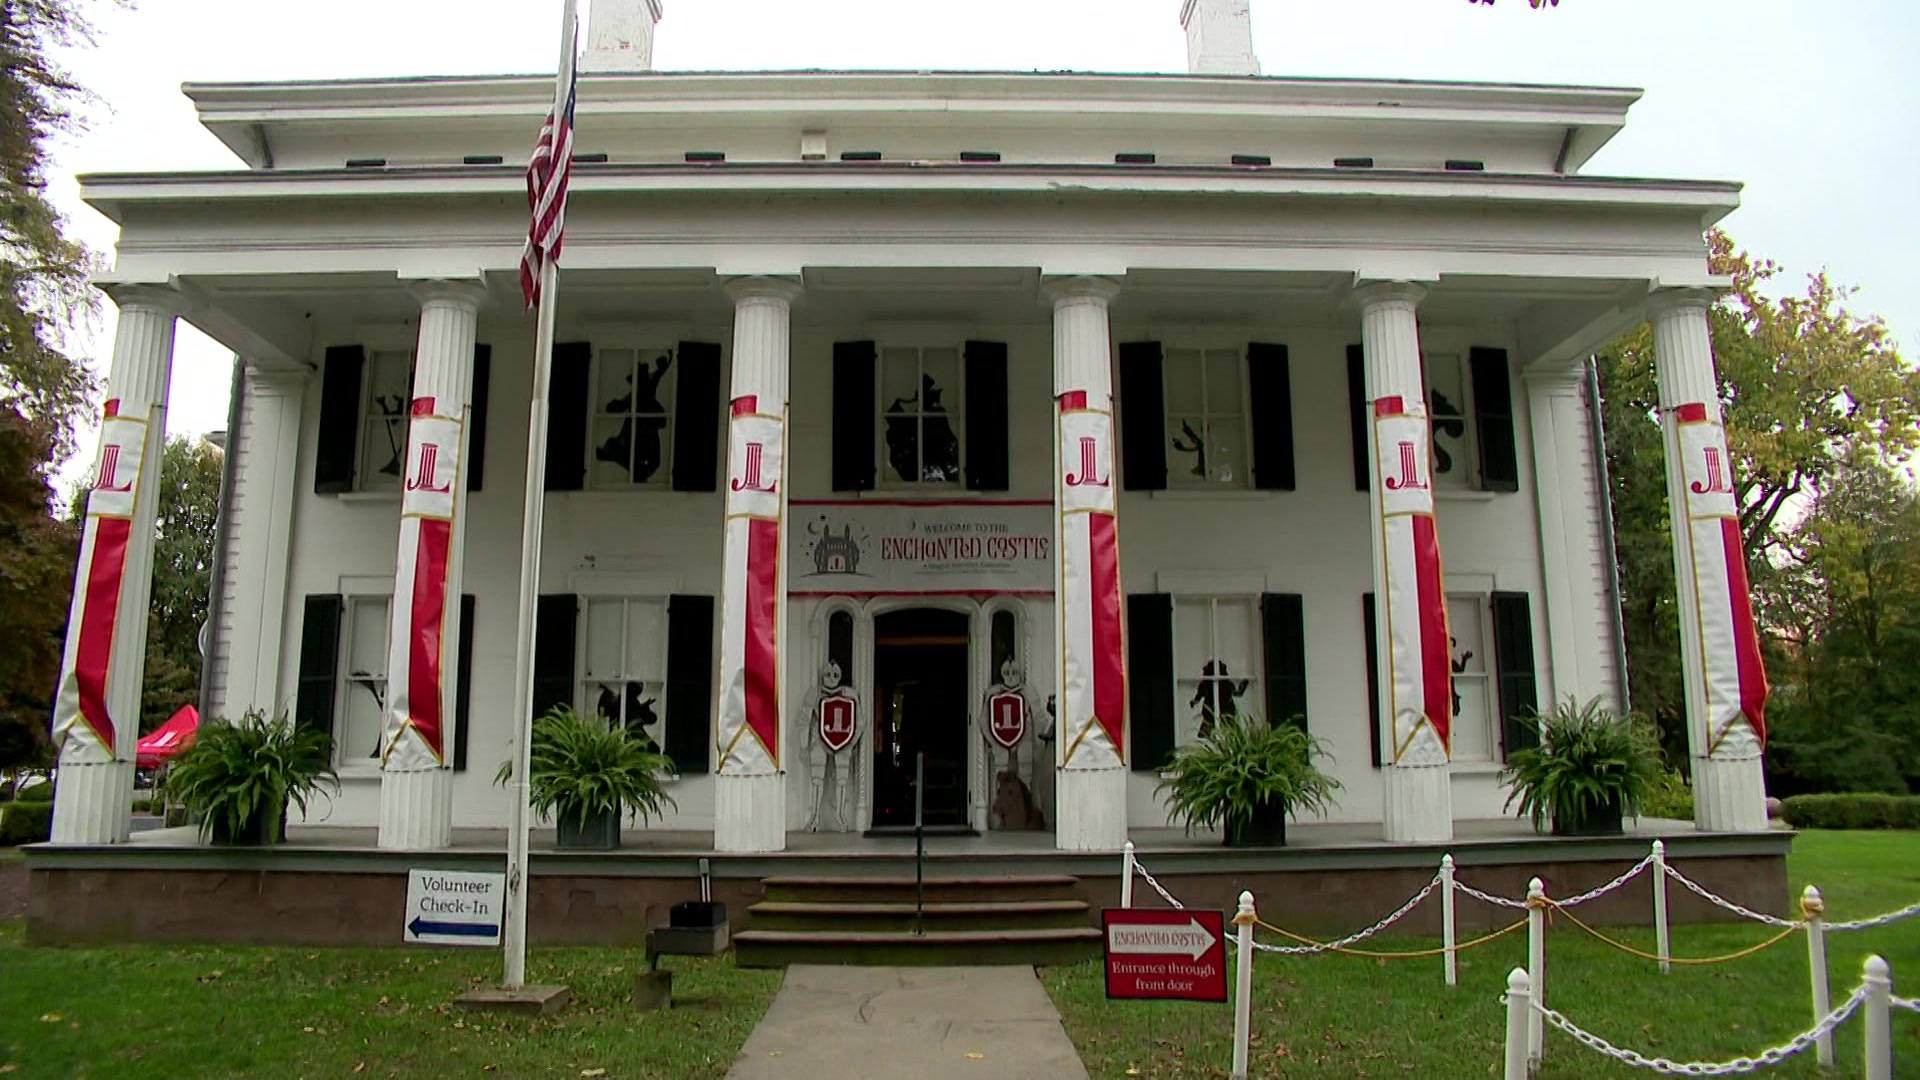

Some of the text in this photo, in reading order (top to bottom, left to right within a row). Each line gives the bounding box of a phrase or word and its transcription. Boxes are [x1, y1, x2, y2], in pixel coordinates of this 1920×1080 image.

[923, 523, 1009, 534] WELCOME TO THE
[421, 877, 493, 893] Volunteer
[420, 895, 489, 914] Check-In
[1112, 961, 1216, 979] Entrance through
[1136, 978, 1194, 992] front door
